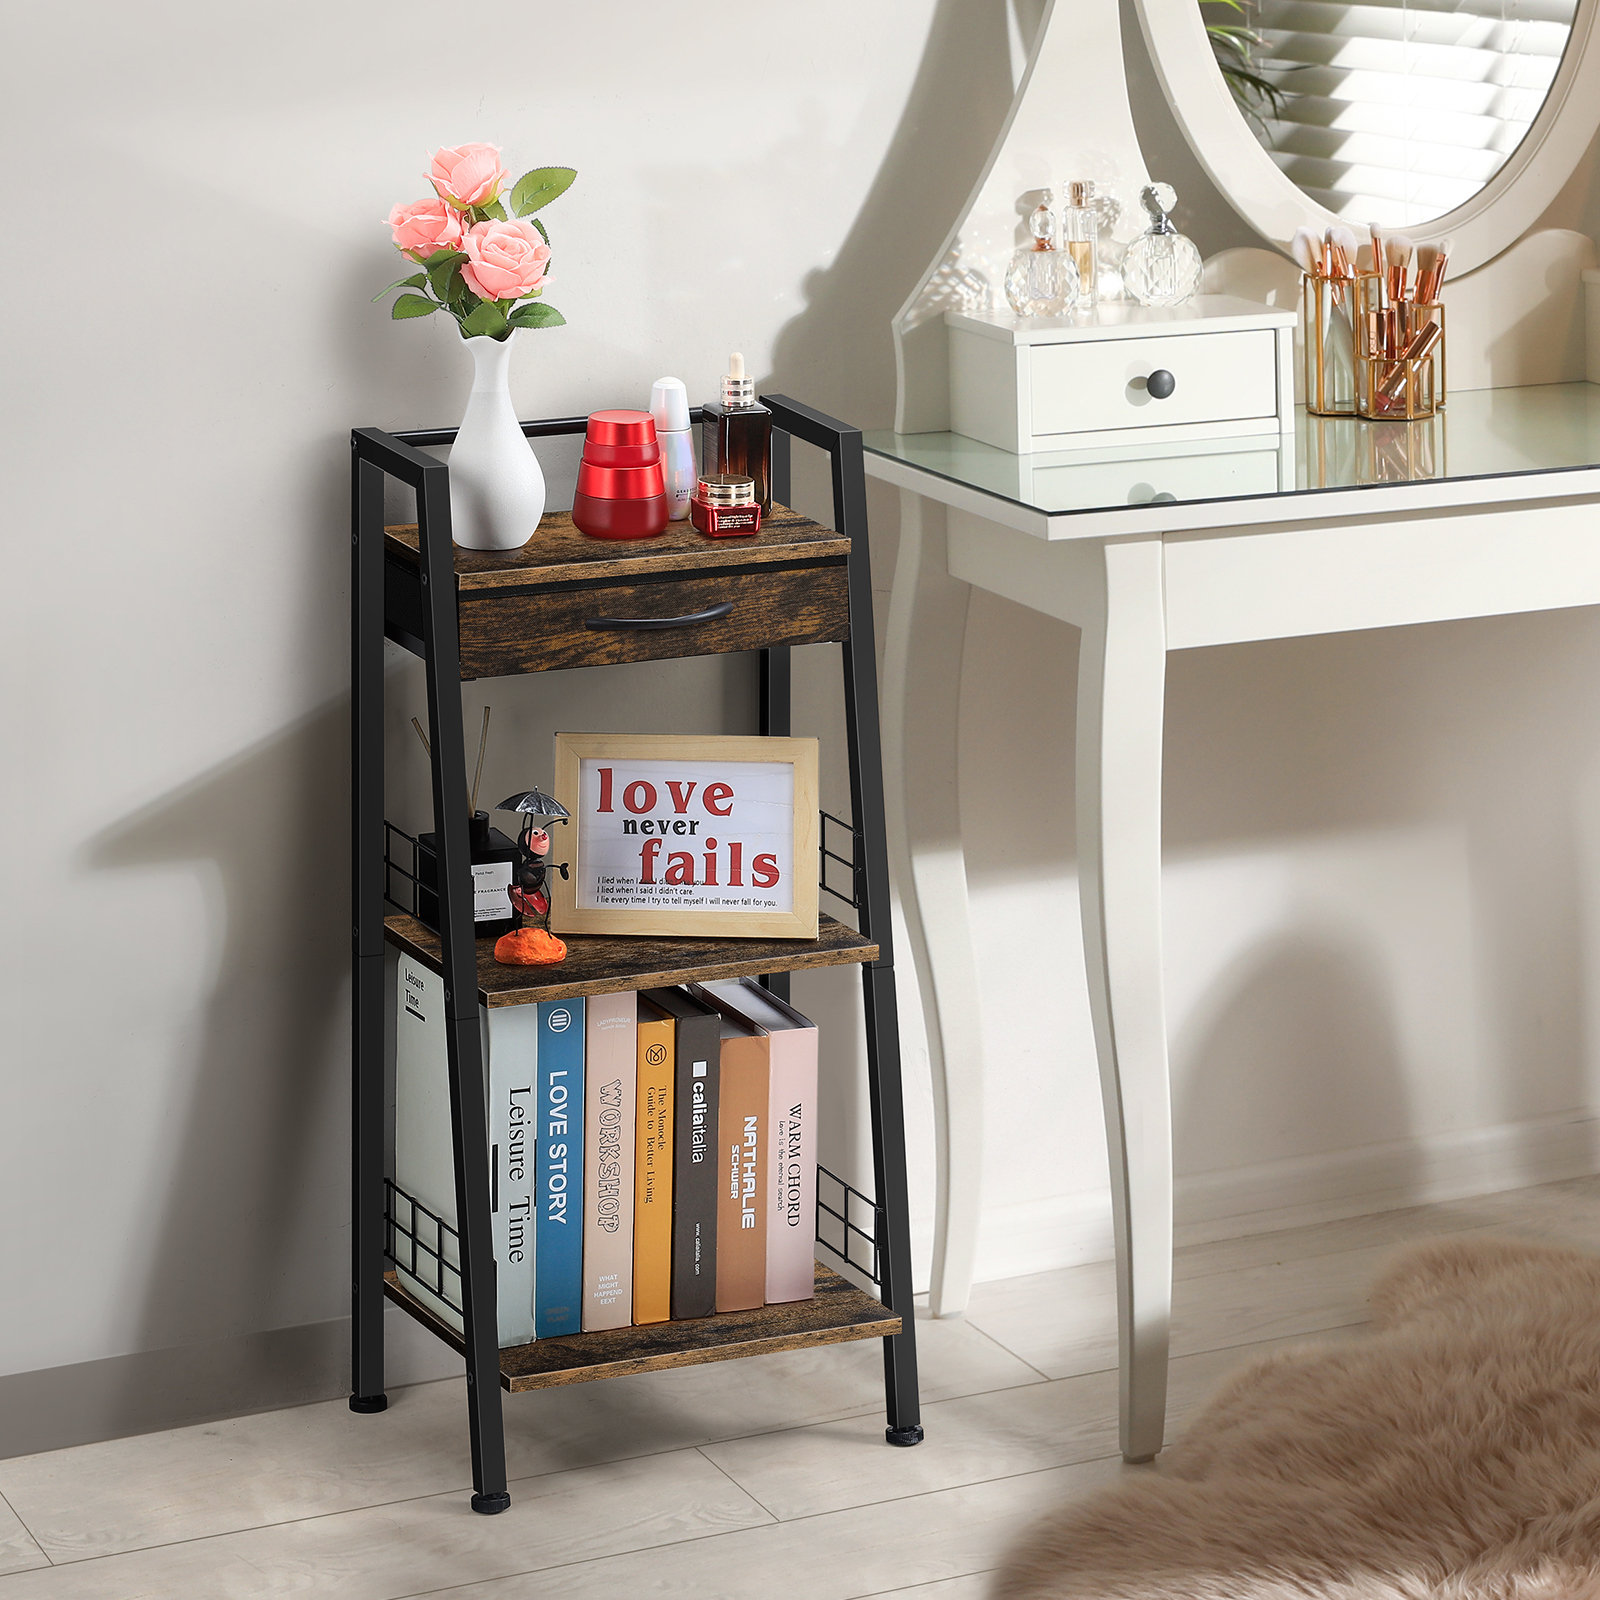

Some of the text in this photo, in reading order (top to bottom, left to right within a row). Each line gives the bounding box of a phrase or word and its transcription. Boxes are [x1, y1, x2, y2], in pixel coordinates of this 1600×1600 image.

[597, 768, 734, 816] love
[623, 819, 699, 835] never
[616, 877, 634, 885] when
[639, 837, 780, 888] fails
[601, 895, 609, 903] lie
[611, 897, 629, 905] every
[652, 897, 660, 905] try
[684, 897, 704, 906] myself
[753, 898, 762, 906] for
[764, 899, 777, 907] you.
[405, 968, 424, 991] Leisure
[405, 989, 419, 1008] Time
[657, 1085, 667, 1151] The Monocle
[692, 1081, 708, 1164] caliaitalia
[548, 1070, 568, 1225] LOVE STORY
[597, 1078, 622, 1233] WORKSHOP
[644, 1086, 656, 1204] Guide to Better Living
[787, 1103, 802, 1227] WARM CHORD
[508, 1085, 531, 1263] Leisure Time
[730, 1145, 739, 1199] SCHWER
[741, 1116, 758, 1229] NATHALIE
[777, 1162, 785, 1185] eternal
[593, 1289, 623, 1298] HAPPEND
[598, 1274, 618, 1282] WHAT
